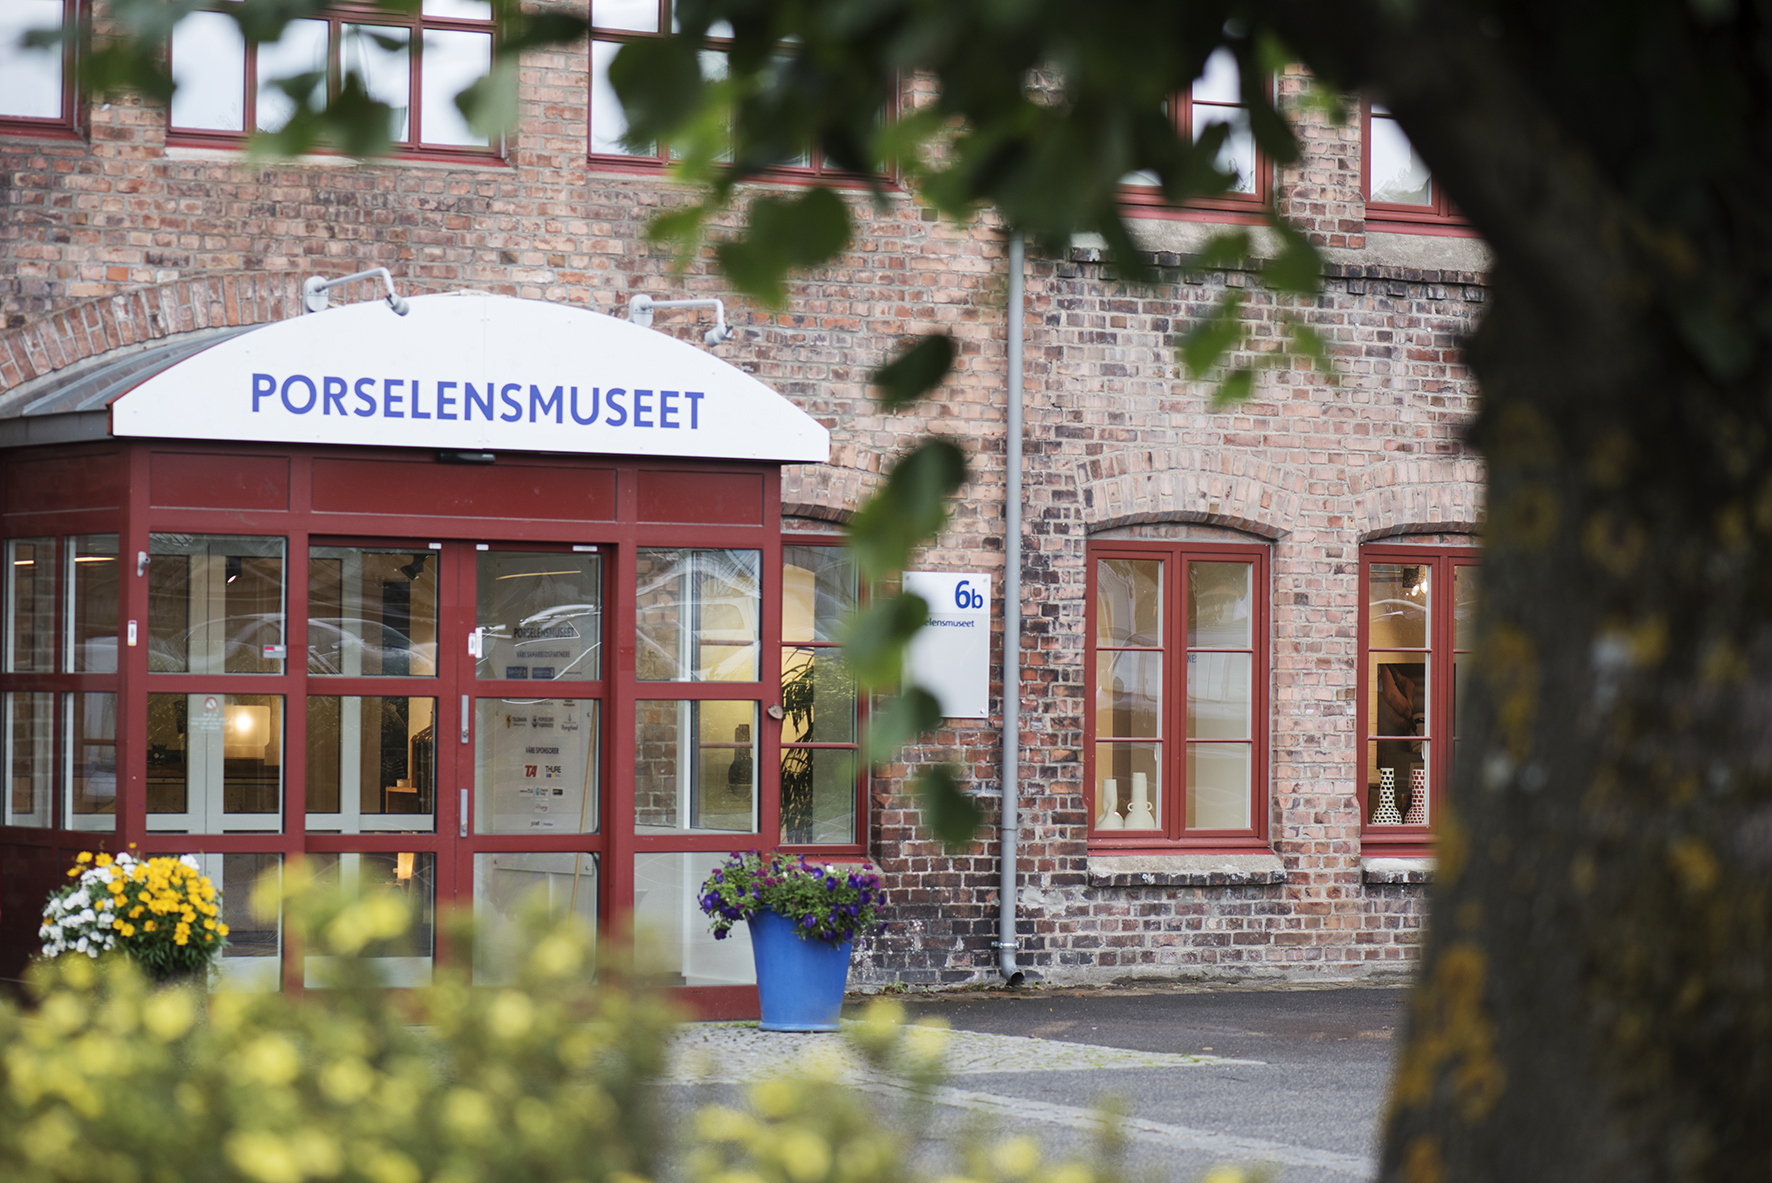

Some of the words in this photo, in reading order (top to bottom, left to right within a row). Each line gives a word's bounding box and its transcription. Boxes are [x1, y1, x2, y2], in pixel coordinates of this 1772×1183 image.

[252, 373, 704, 430] PORSELENSMUSEET
[955, 580, 983, 609] 6b
[924, 618, 975, 628] elensmuseet
[514, 627, 574, 639] PORSELENSMUSEET
[525, 765, 538, 778] TA
